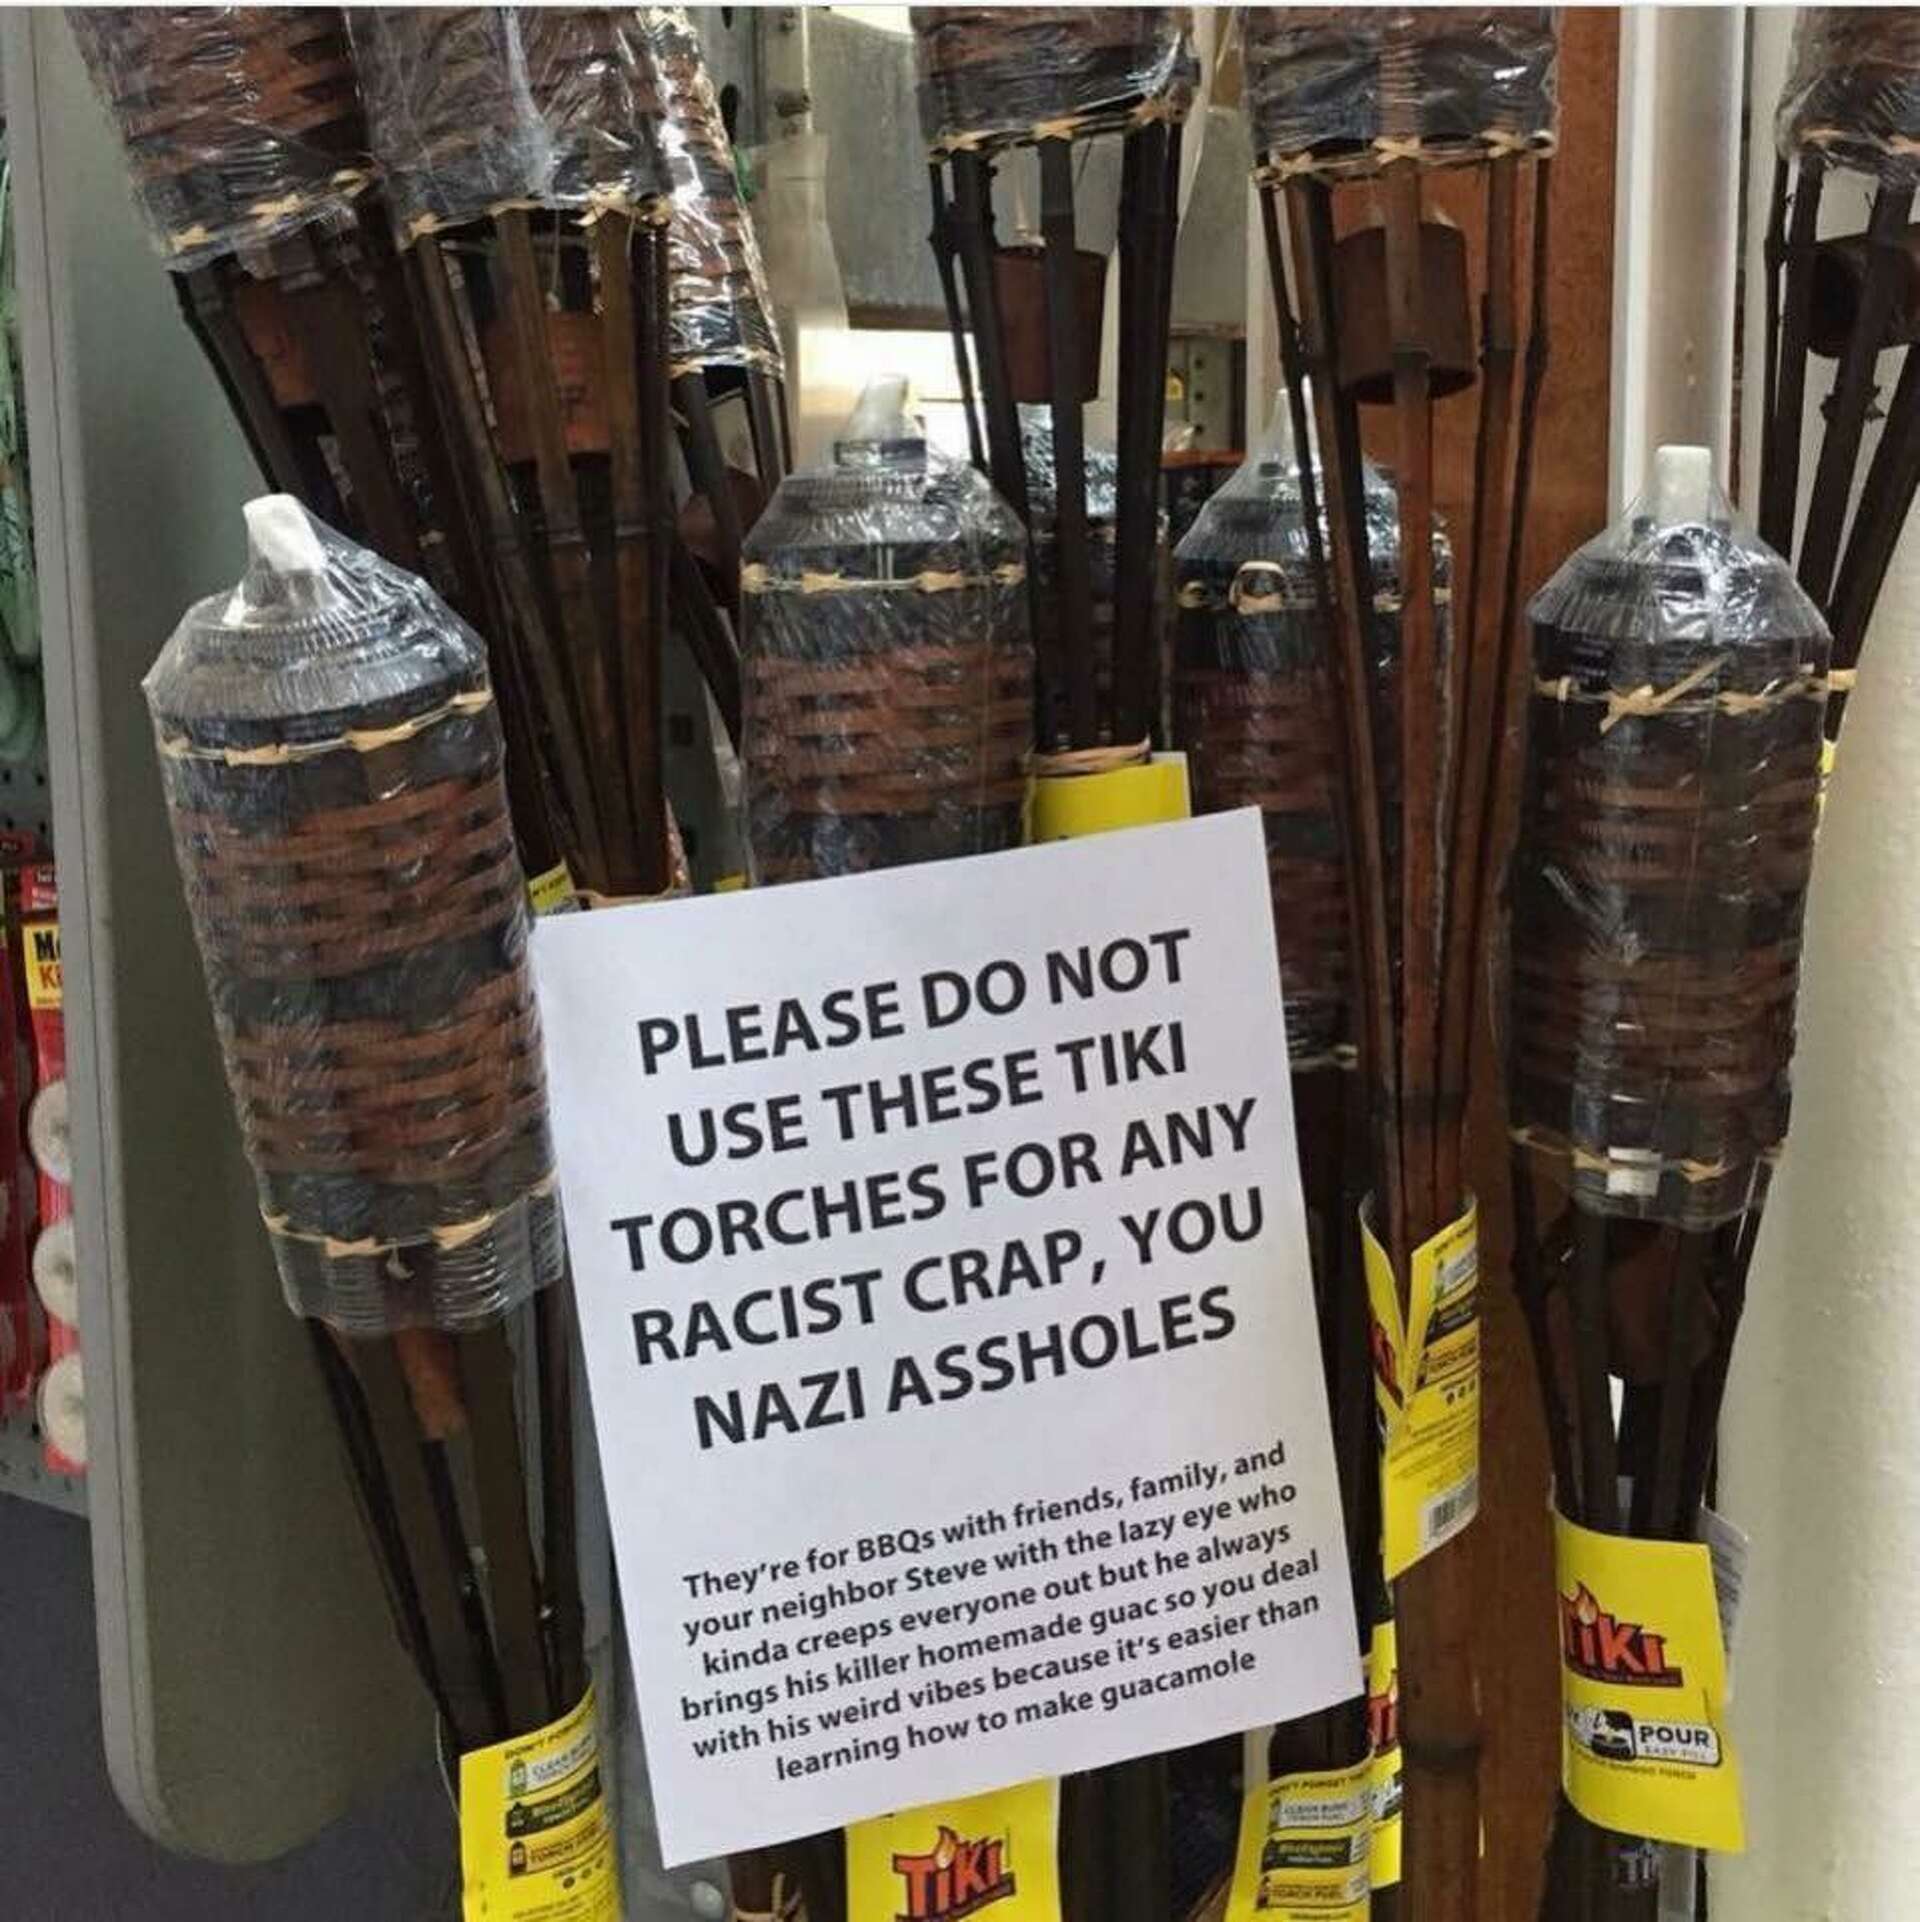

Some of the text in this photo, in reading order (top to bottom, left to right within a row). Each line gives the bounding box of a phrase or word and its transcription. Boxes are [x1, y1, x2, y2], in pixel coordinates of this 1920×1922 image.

[637, 927, 1191, 1075] PLEASE DO NOT
[666, 1020, 1187, 1167] USE THESE TIKI
[609, 1096, 1257, 1272] TORCHES FOR ANY
[631, 1185, 1263, 1366] RACIST CRAP, YOU
[692, 1284, 1236, 1450] NAZI ASSHOLES
[681, 1439, 1286, 1598] They're for BBQs with friends, family, and
[682, 1483, 1297, 1647] your neighbor Steve with the lazy eye who
[680, 1547, 1319, 1721] brings his killer homemade guac so you deal
[691, 1594, 1319, 1758] with his weird vibes because it's easier than
[701, 1523, 1291, 1676] kinda creeps everyone out but he always
[775, 1648, 1255, 1781] learning how to make guacamole
[1638, 1725, 1711, 1747] POUR
